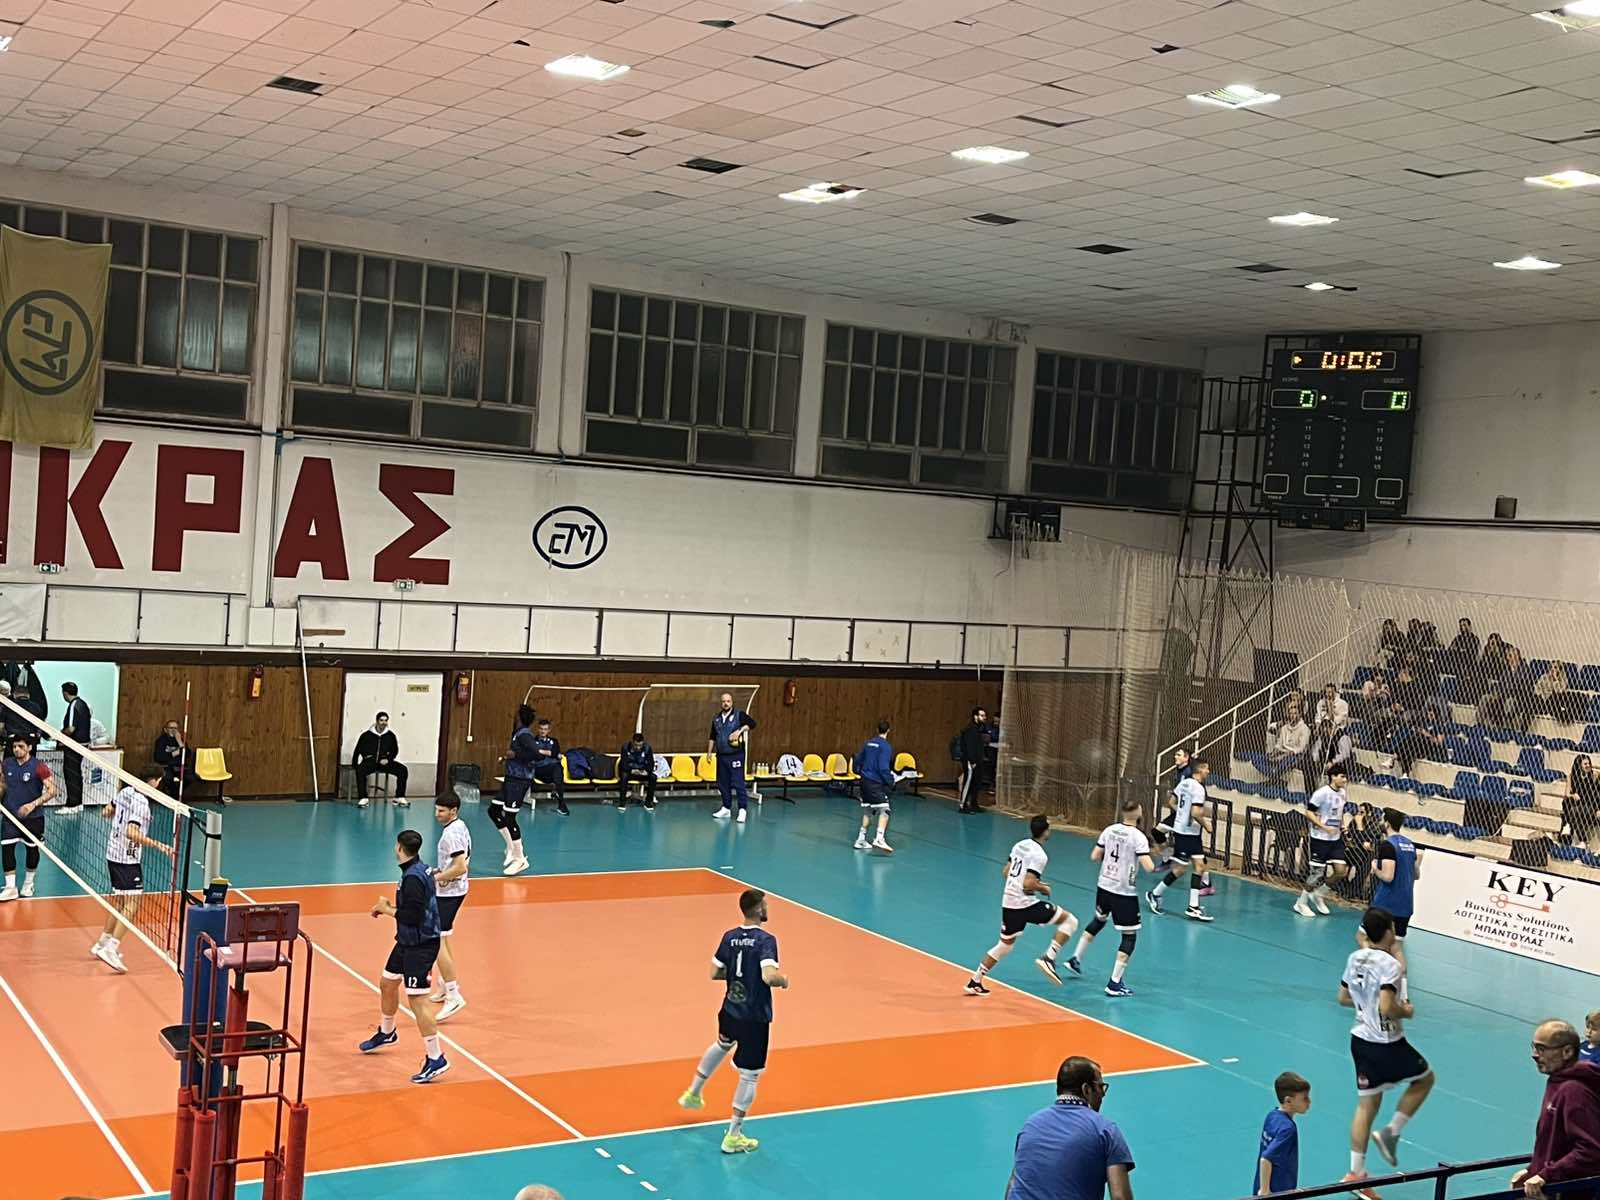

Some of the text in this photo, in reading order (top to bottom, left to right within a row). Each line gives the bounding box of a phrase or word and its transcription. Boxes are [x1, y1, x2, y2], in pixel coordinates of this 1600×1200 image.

[1299, 390, 1314, 407] 0
[1391, 391, 1408, 409] 0
[1110, 843, 1120, 863] 4
[1488, 870, 1566, 902] KEY
[1465, 900, 1570, 932] Business Solutions
[736, 950, 743, 977] 1
[408, 976, 417, 988] 12
